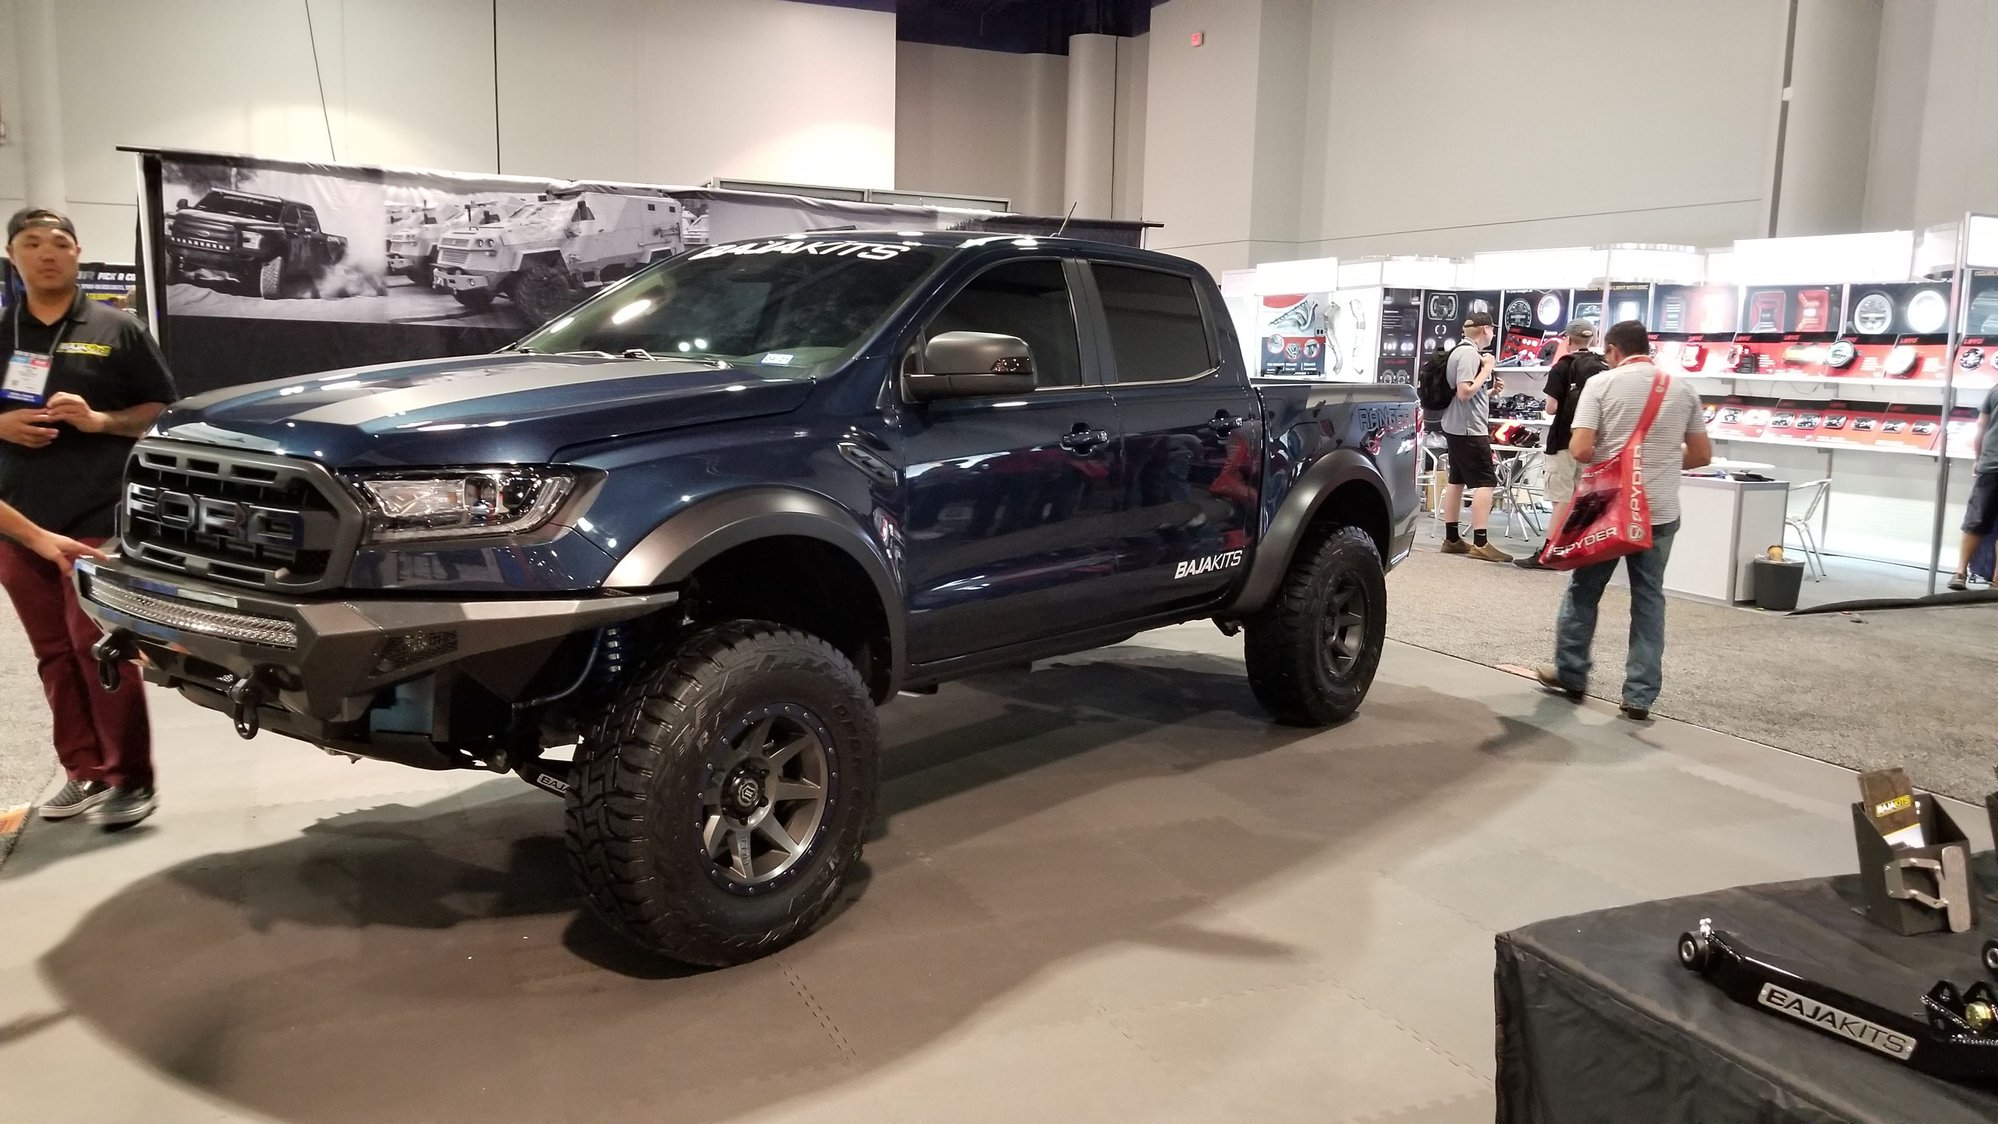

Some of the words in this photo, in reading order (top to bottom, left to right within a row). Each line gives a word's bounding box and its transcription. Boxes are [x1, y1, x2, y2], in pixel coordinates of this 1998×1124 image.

[688, 240, 911, 260] BAJAKITS
[1631, 445, 1642, 522] SPYDER
[127, 482, 305, 547] FORD
[1553, 526, 1617, 556] SPYDER
[1174, 550, 1243, 579] BAJAKITS
[541, 776, 568, 791] BAJ
[1765, 988, 1907, 1054] BAJAKITS
